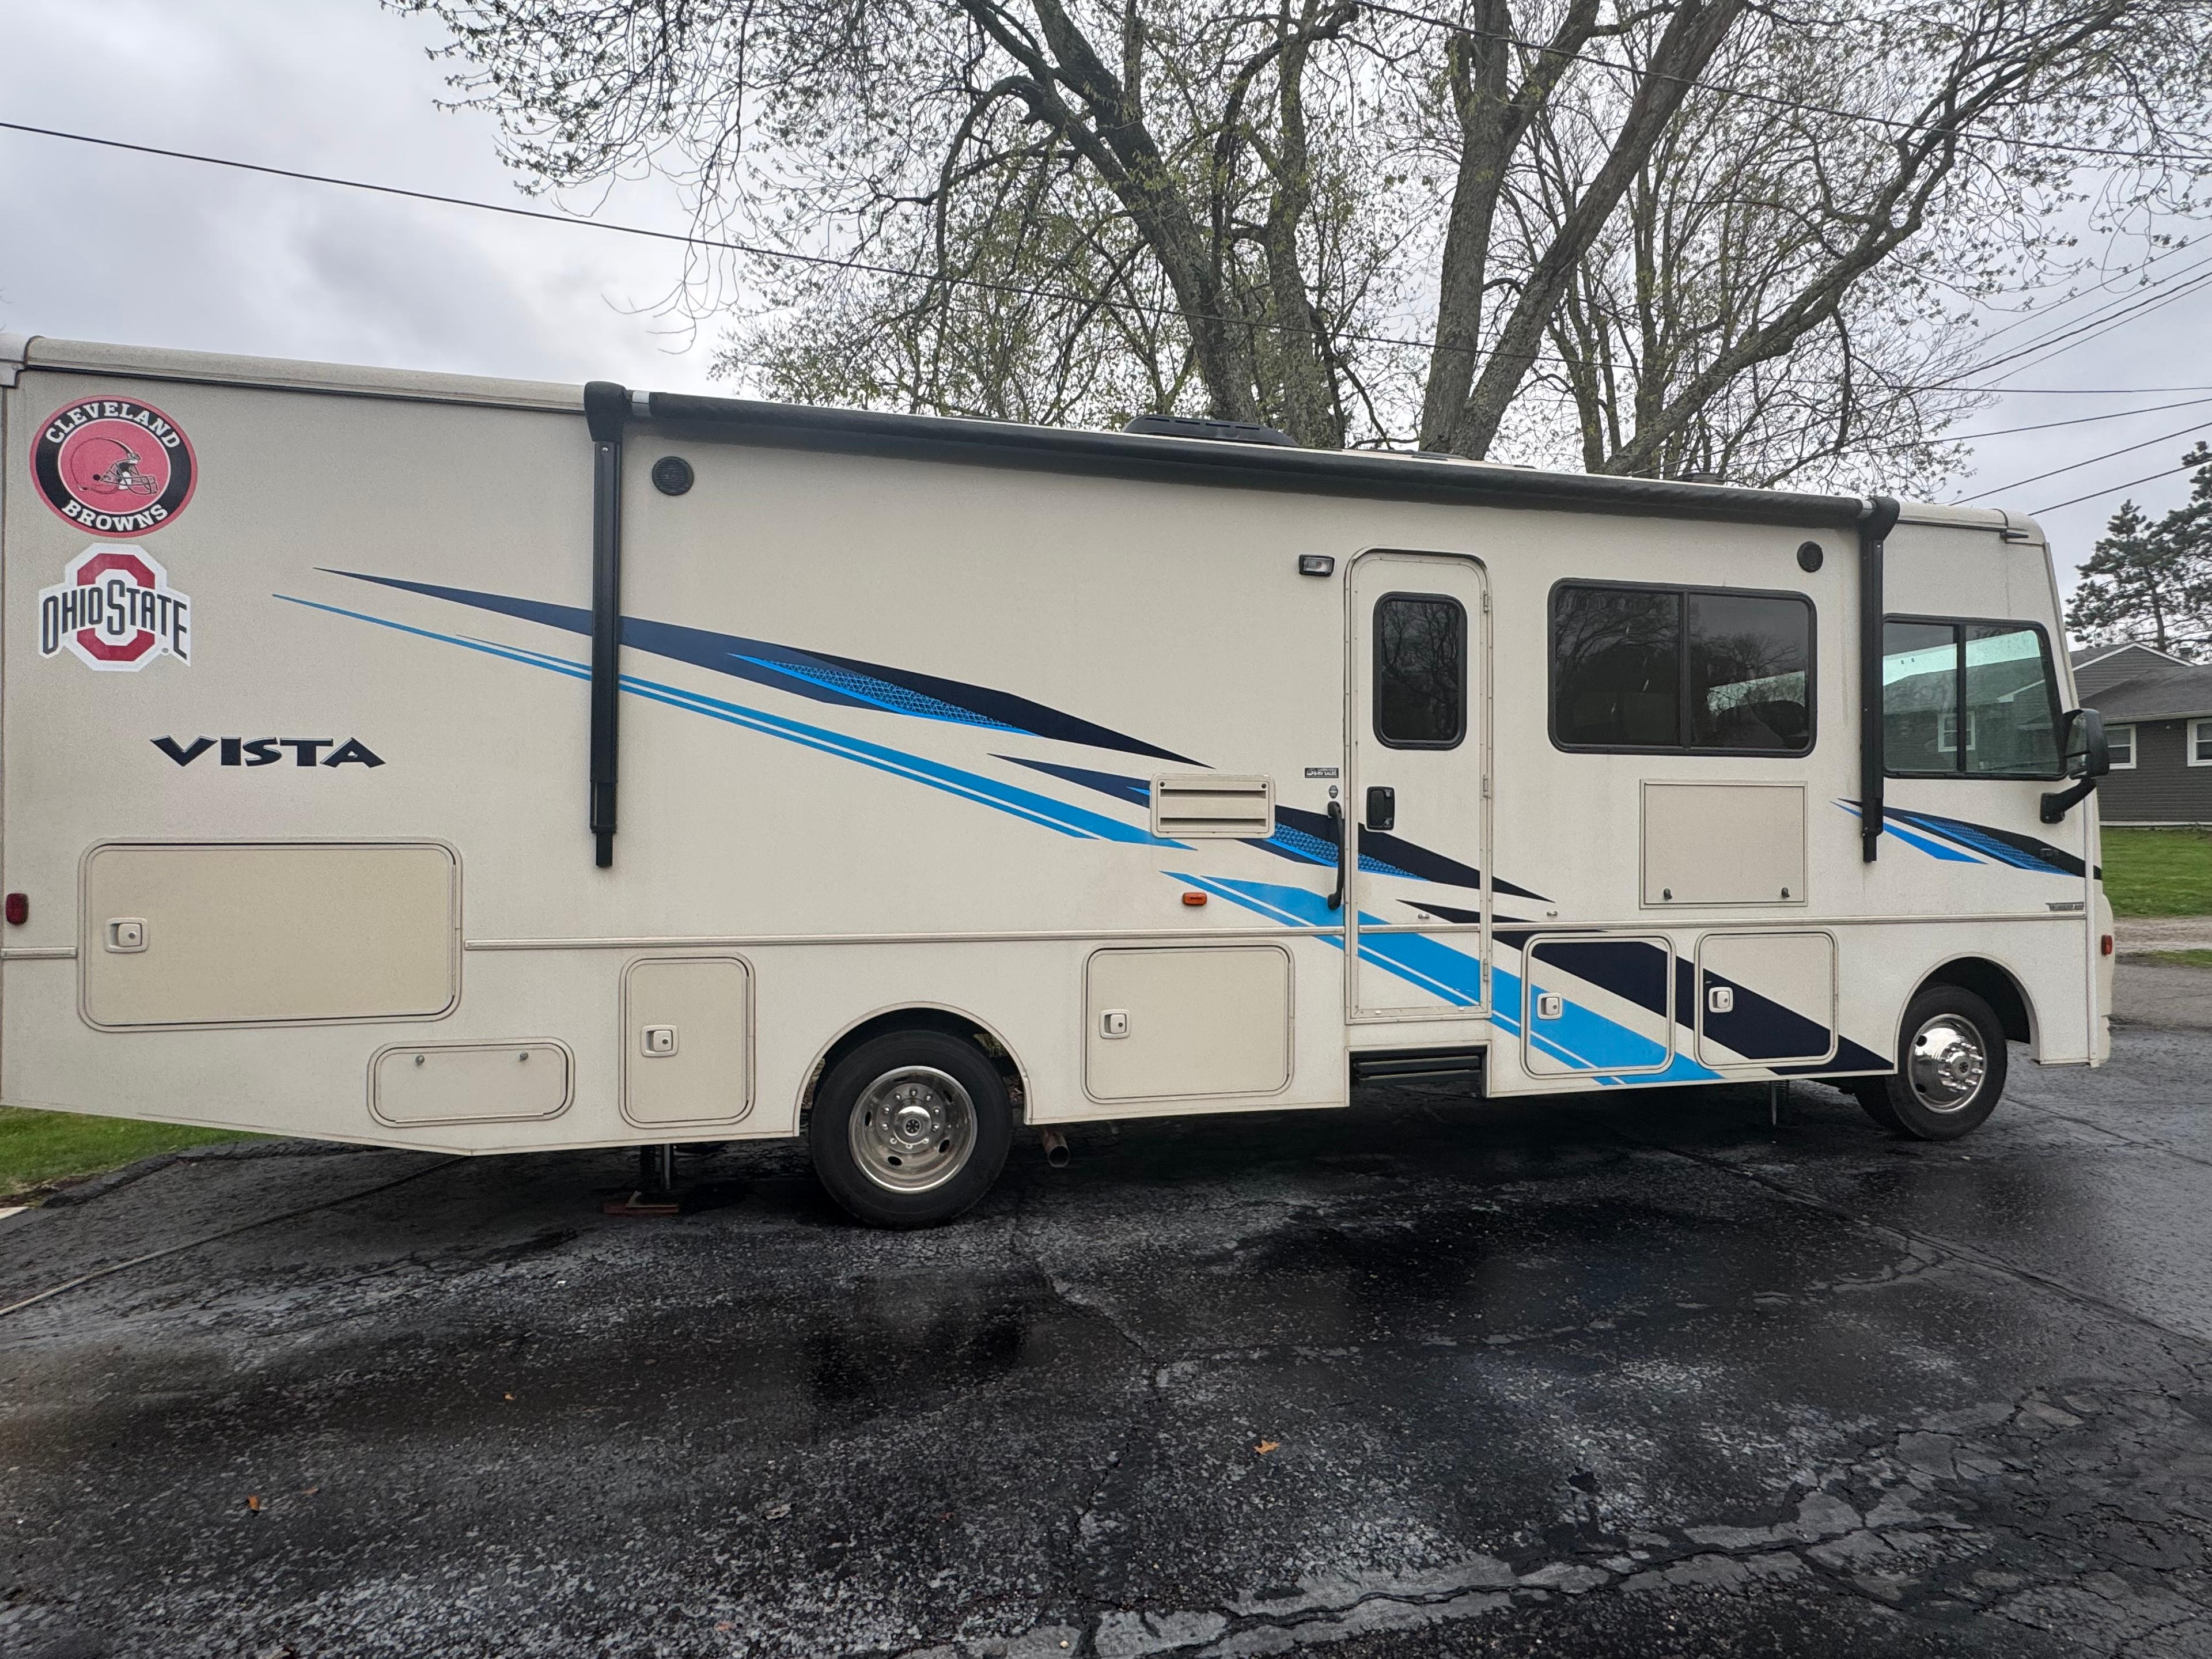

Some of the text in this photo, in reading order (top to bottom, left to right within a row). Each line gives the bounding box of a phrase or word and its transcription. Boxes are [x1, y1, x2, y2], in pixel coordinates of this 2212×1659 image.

[46, 402, 181, 448] CLEVELAND
[62, 499, 168, 531] BROWNS
[43, 579, 187, 660] OHIO STATE
[150, 735, 387, 768] VISTA
